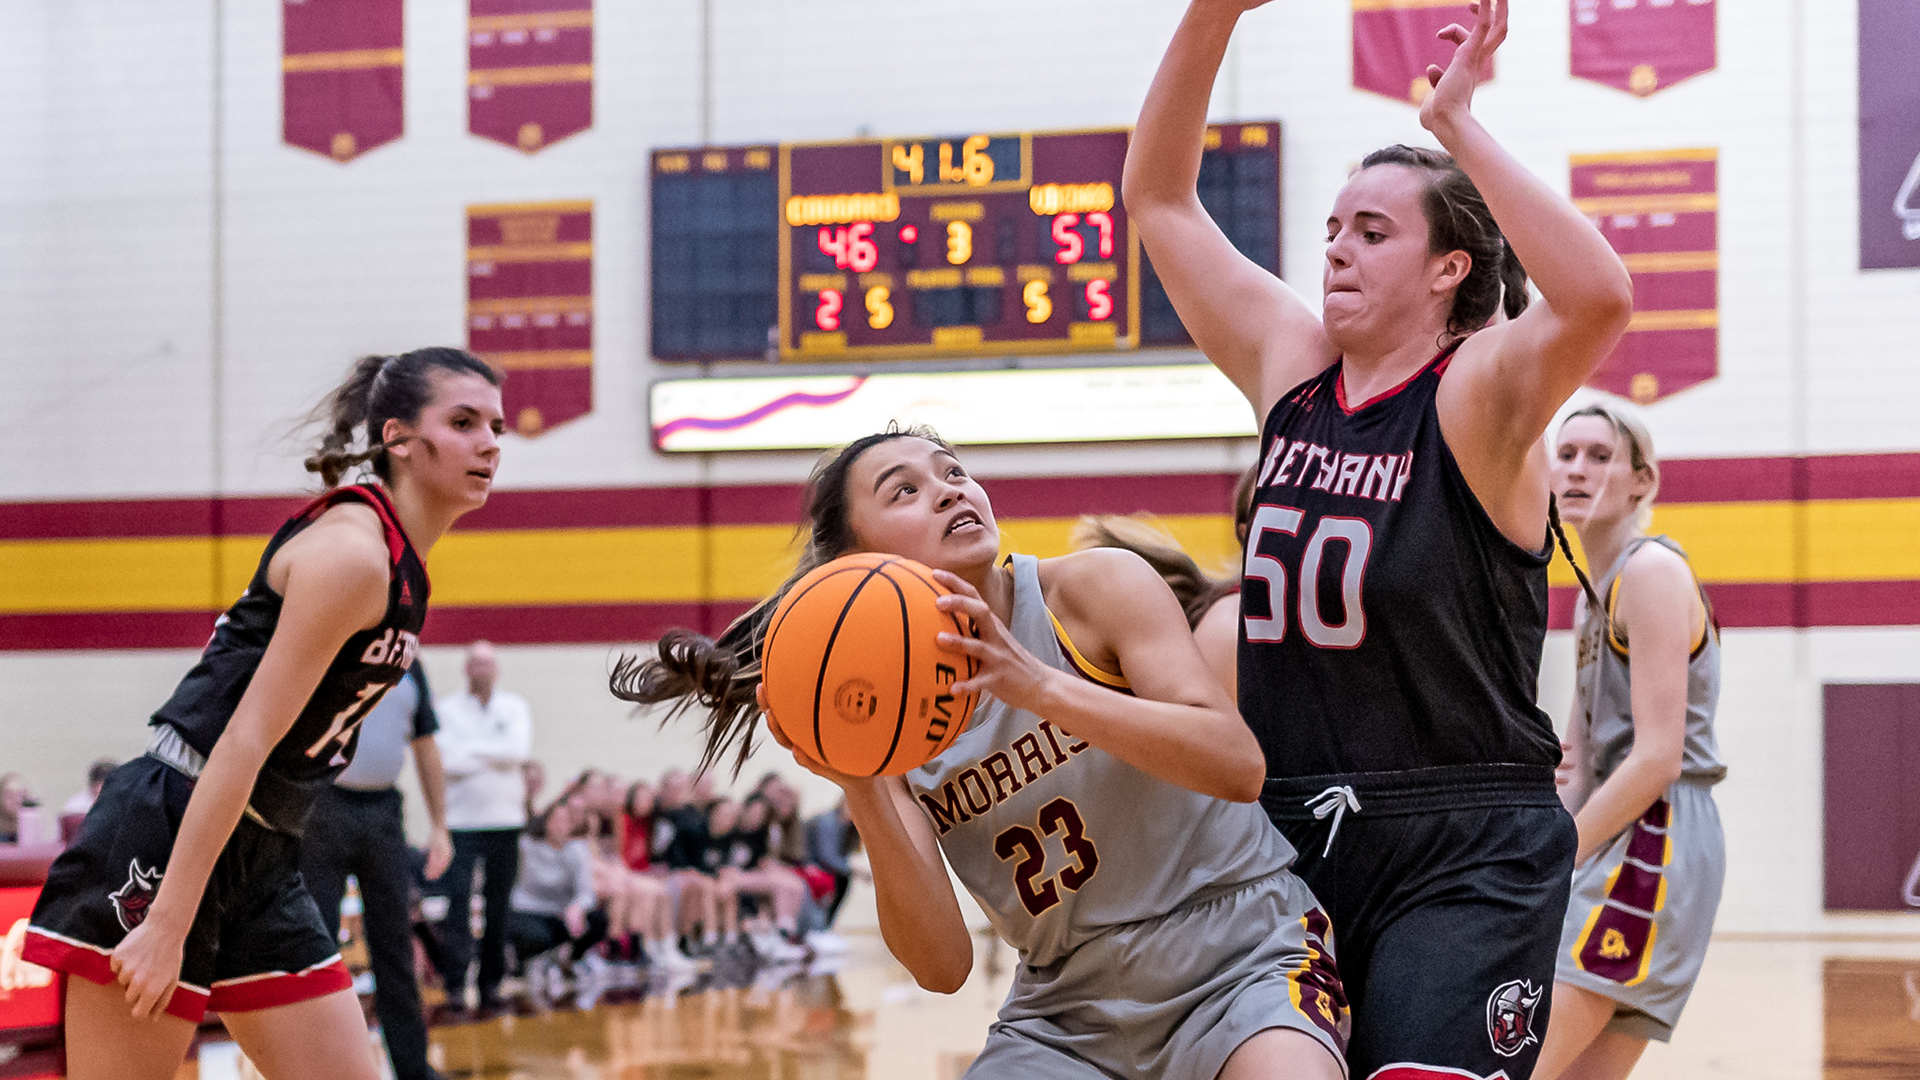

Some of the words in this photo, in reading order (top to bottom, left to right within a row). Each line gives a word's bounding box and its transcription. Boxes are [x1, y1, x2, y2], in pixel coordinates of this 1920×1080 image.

[817, 221, 879, 272] 46
[947, 220, 973, 265] 3
[1051, 211, 1115, 265] 57
[815, 287, 844, 332] 2
[865, 285, 895, 330] 5
[1023, 279, 1053, 324] 5
[1085, 277, 1115, 321] 5
[1256, 434, 1414, 502] BETHANY
[1244, 503, 1374, 650] 50
[926, 662, 957, 742] EVO
[993, 796, 1100, 917] 23
